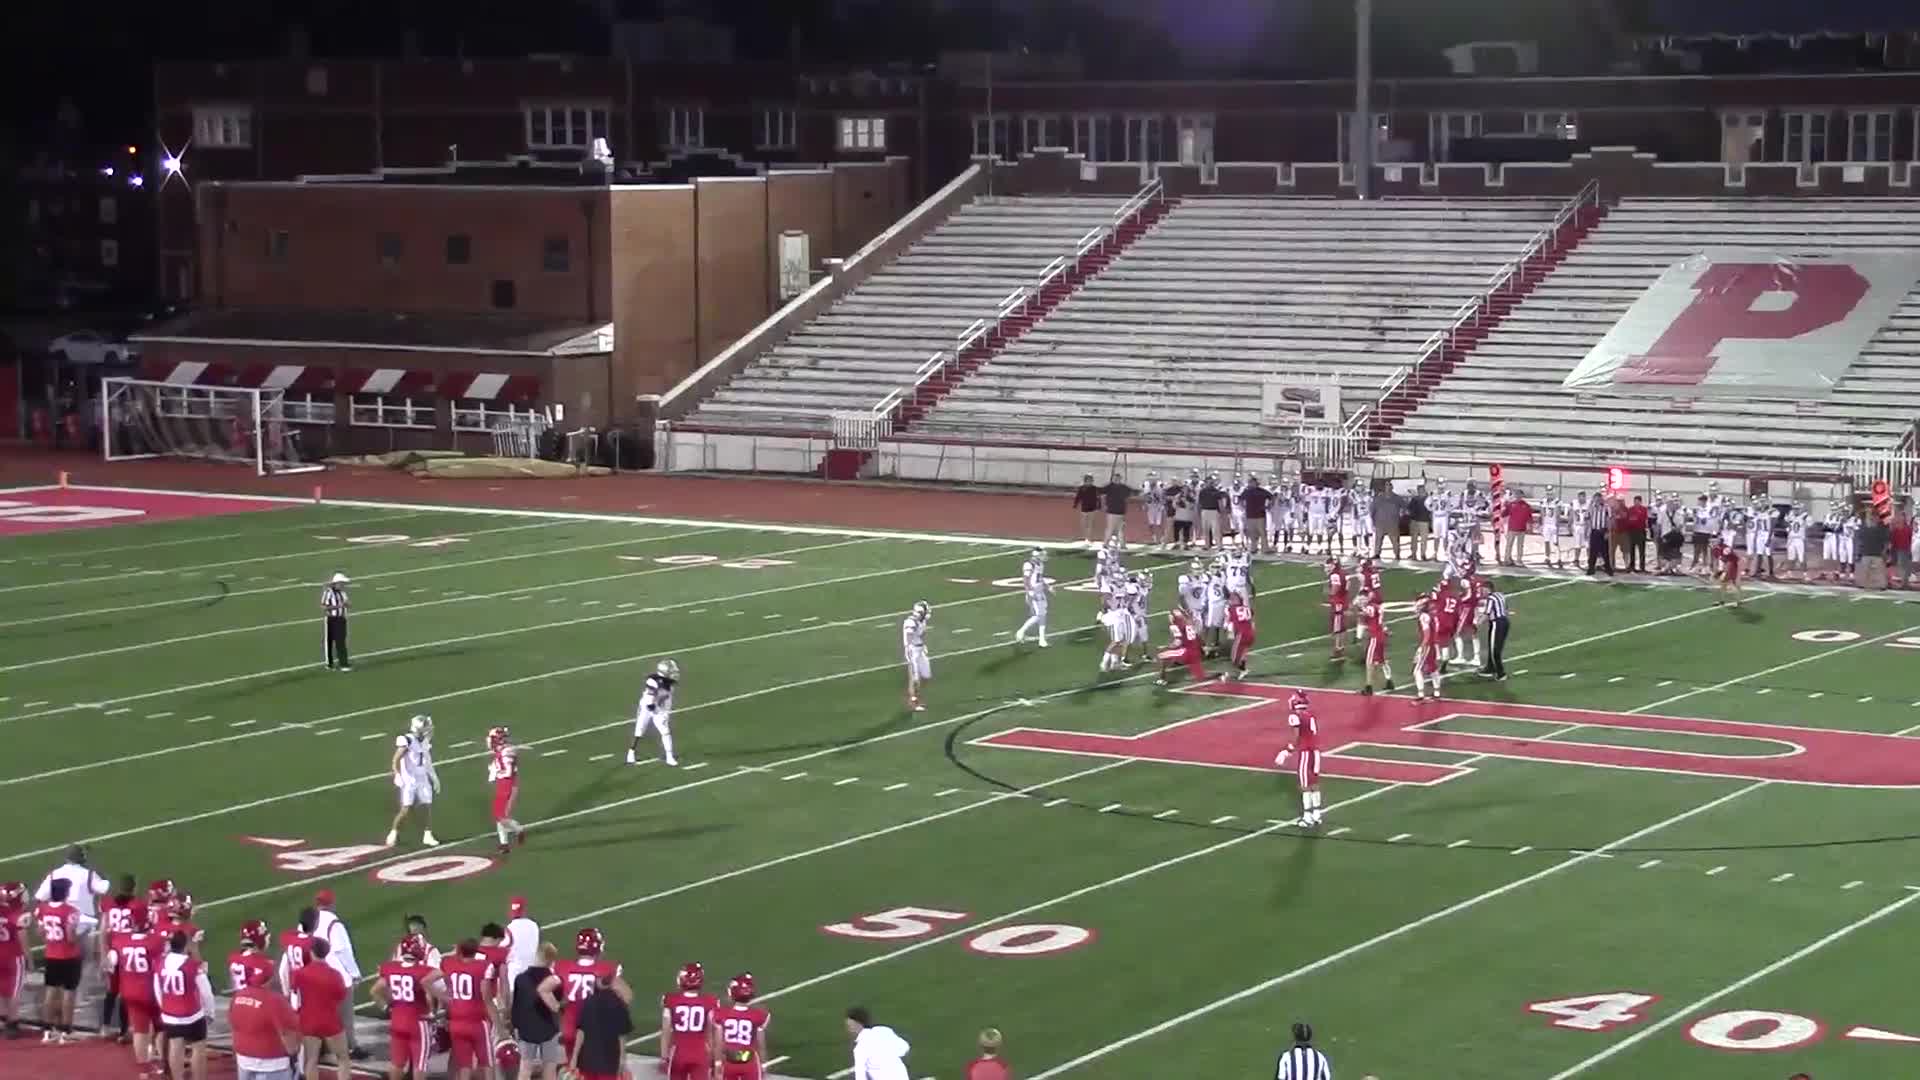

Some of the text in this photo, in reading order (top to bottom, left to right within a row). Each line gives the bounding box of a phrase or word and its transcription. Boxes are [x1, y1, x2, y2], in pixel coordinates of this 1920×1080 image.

[1613, 263, 1872, 385] P
[1610, 468, 1623, 489] 3
[822, 905, 1090, 955] 50
[122, 947, 149, 973] 76
[389, 974, 415, 1002] 58
[450, 973, 473, 1000] 10
[674, 1005, 705, 1032] 30
[724, 1018, 753, 1045] 28
[1528, 993, 1819, 1049] 40
